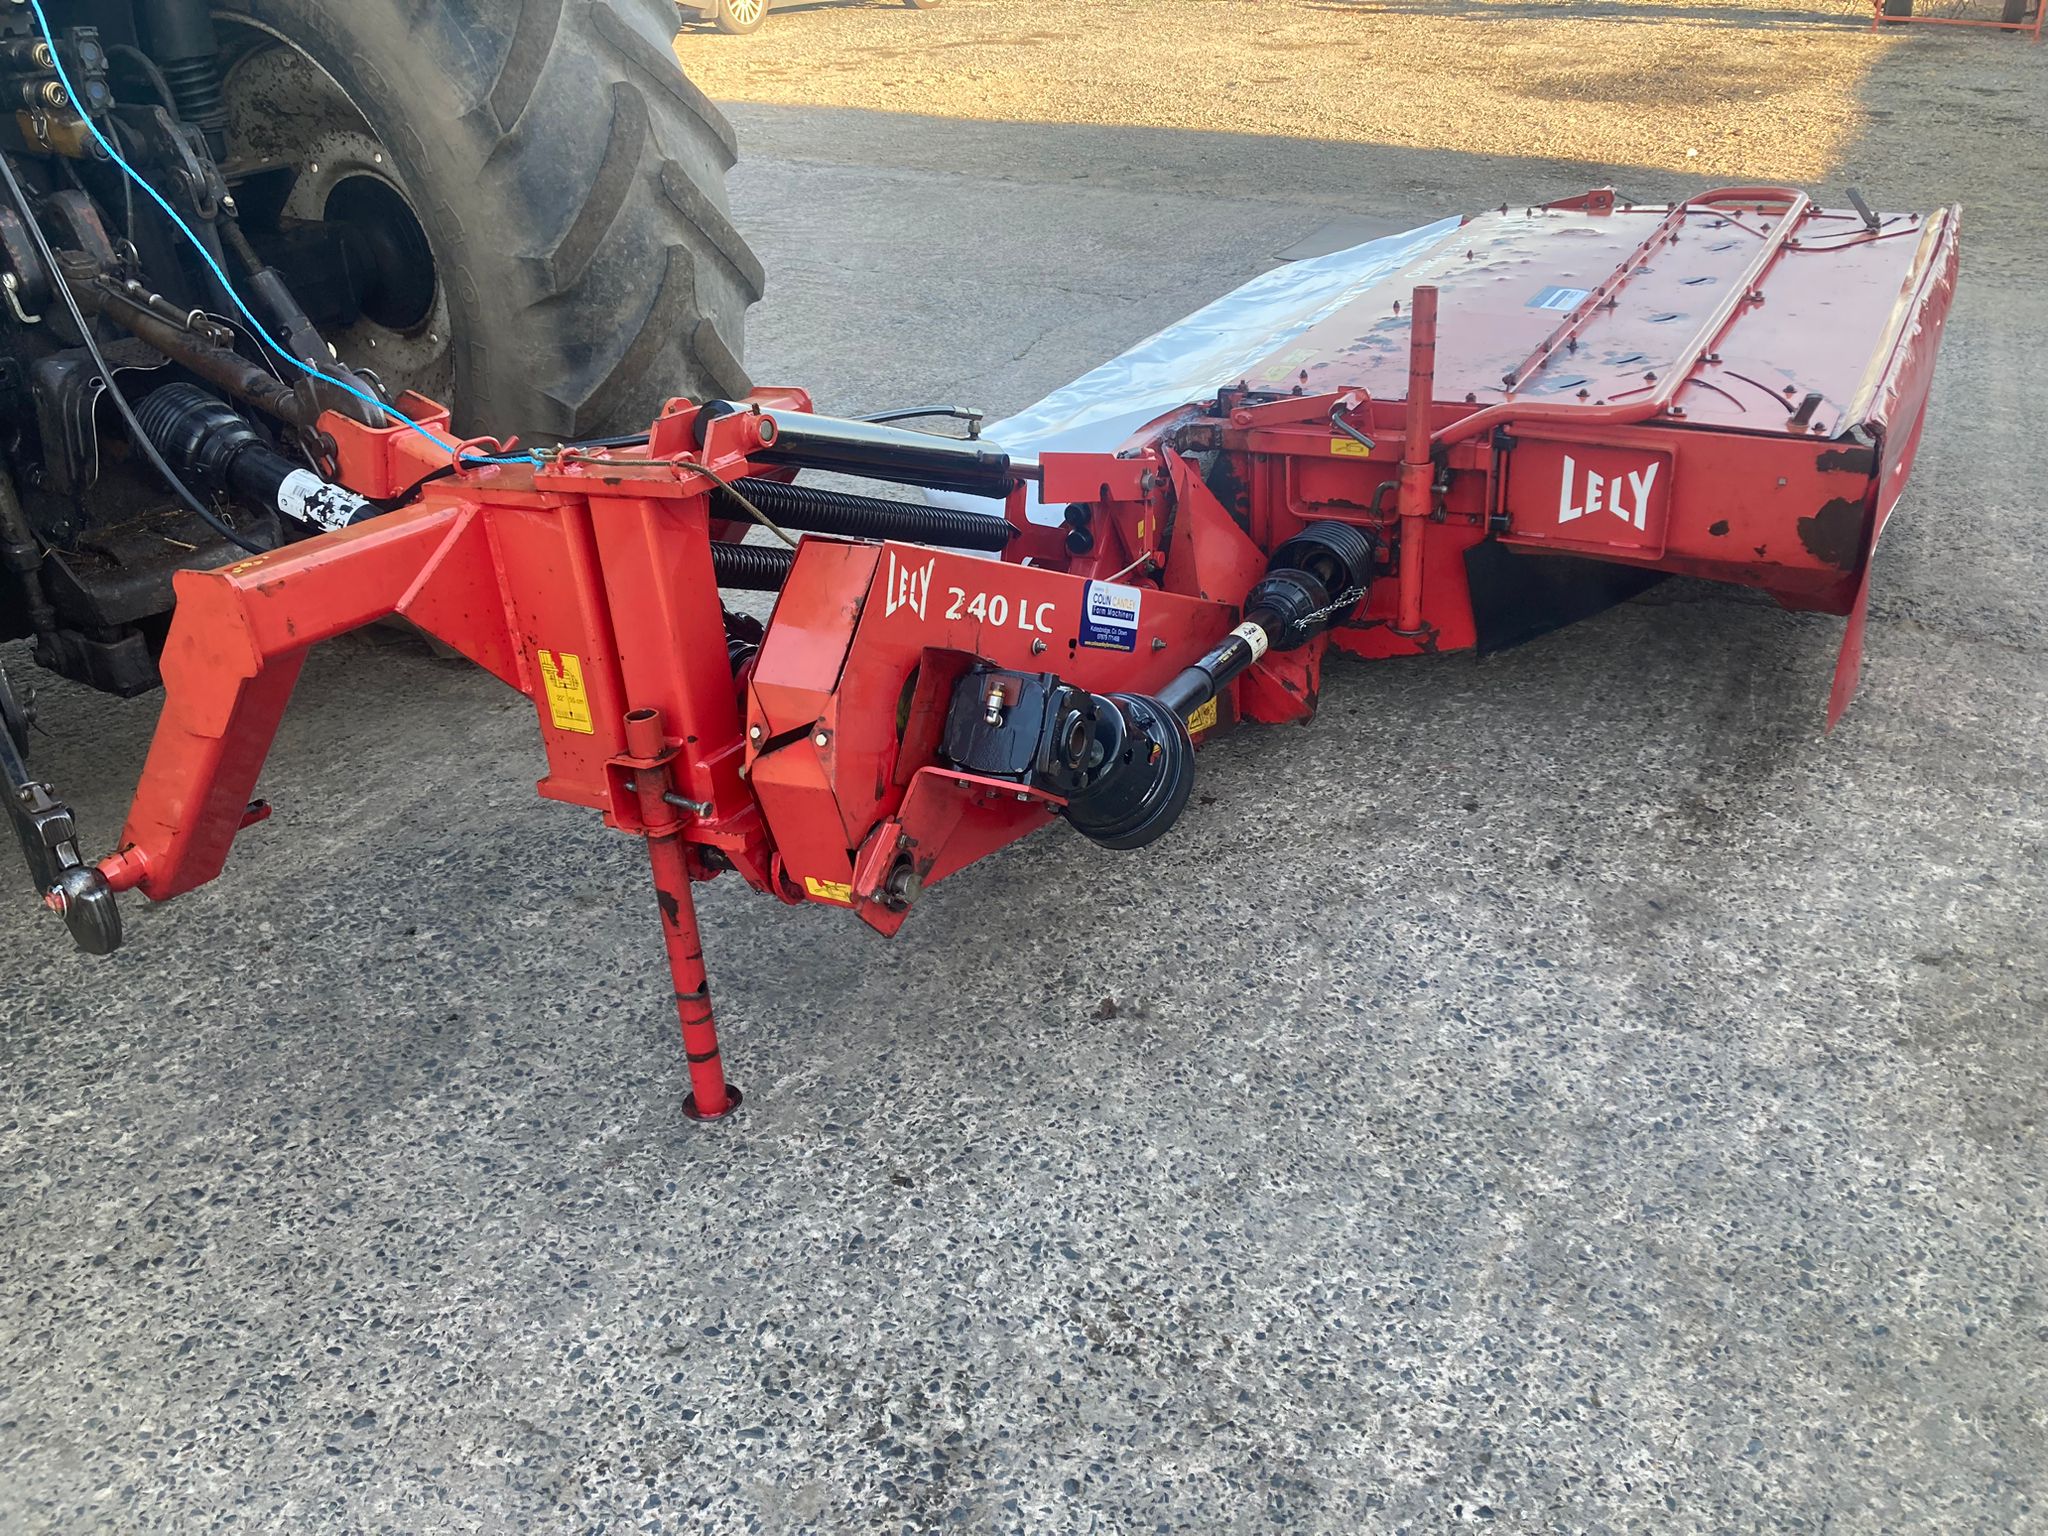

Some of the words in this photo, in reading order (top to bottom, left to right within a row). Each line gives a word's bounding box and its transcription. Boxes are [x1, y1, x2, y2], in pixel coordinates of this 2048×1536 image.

[1558, 454, 1660, 532] LELY
[885, 550, 935, 622] LELY
[945, 587, 1009, 627] 240
[1018, 599, 1056, 634] LC
